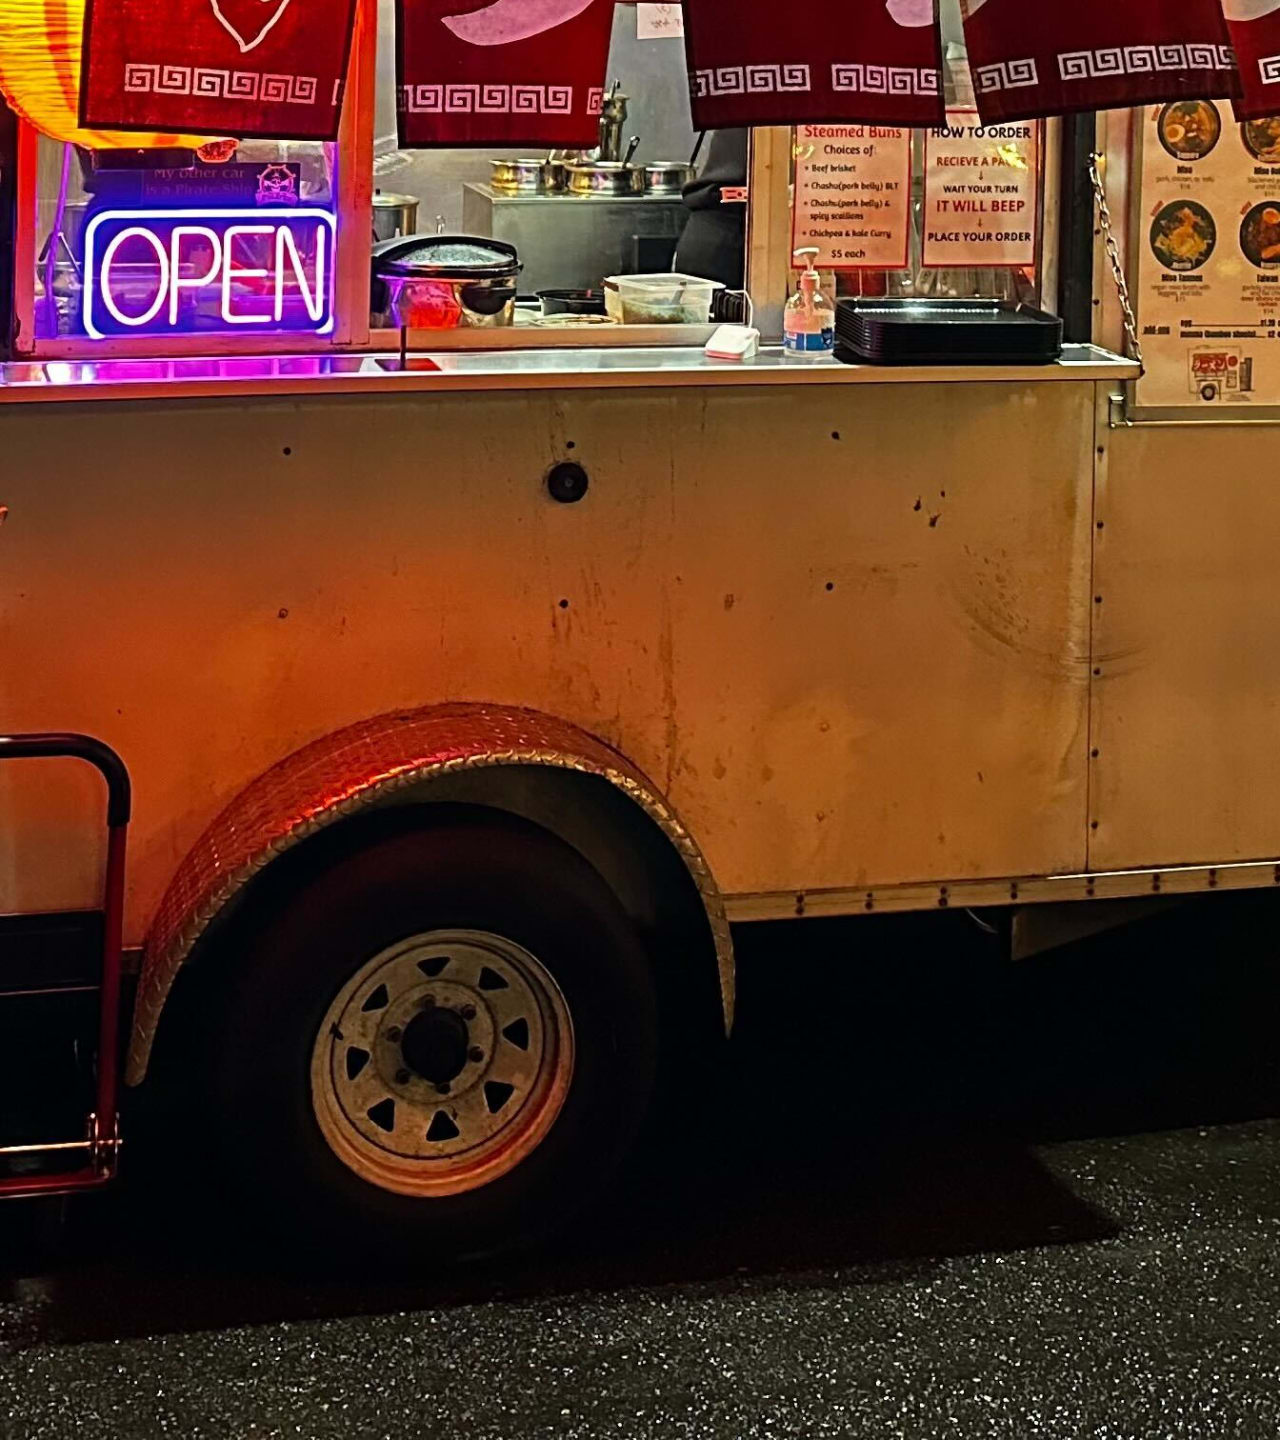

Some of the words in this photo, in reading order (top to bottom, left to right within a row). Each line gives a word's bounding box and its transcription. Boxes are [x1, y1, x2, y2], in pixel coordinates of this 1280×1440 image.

[805, 125, 864, 138] Steamed
[869, 126, 902, 139] Buns
[932, 126, 965, 138] HOW
[968, 126, 984, 138] TO
[988, 127, 1031, 138] ORDER
[824, 145, 861, 155] Choices
[937, 157, 978, 166] RECIEVE
[981, 157, 988, 166] A
[812, 164, 828, 173] Beef
[944, 185, 966, 193] WAIT
[968, 185, 992, 193] YOUR
[995, 185, 1018, 193] TURN
[937, 200, 950, 212] IT
[953, 200, 987, 212] WILL
[992, 200, 1025, 212] BEEP
[928, 233, 960, 241] PLACE
[963, 233, 992, 241] YOUR
[995, 233, 1031, 241] ORDER
[100, 225, 325, 326] OPEN
